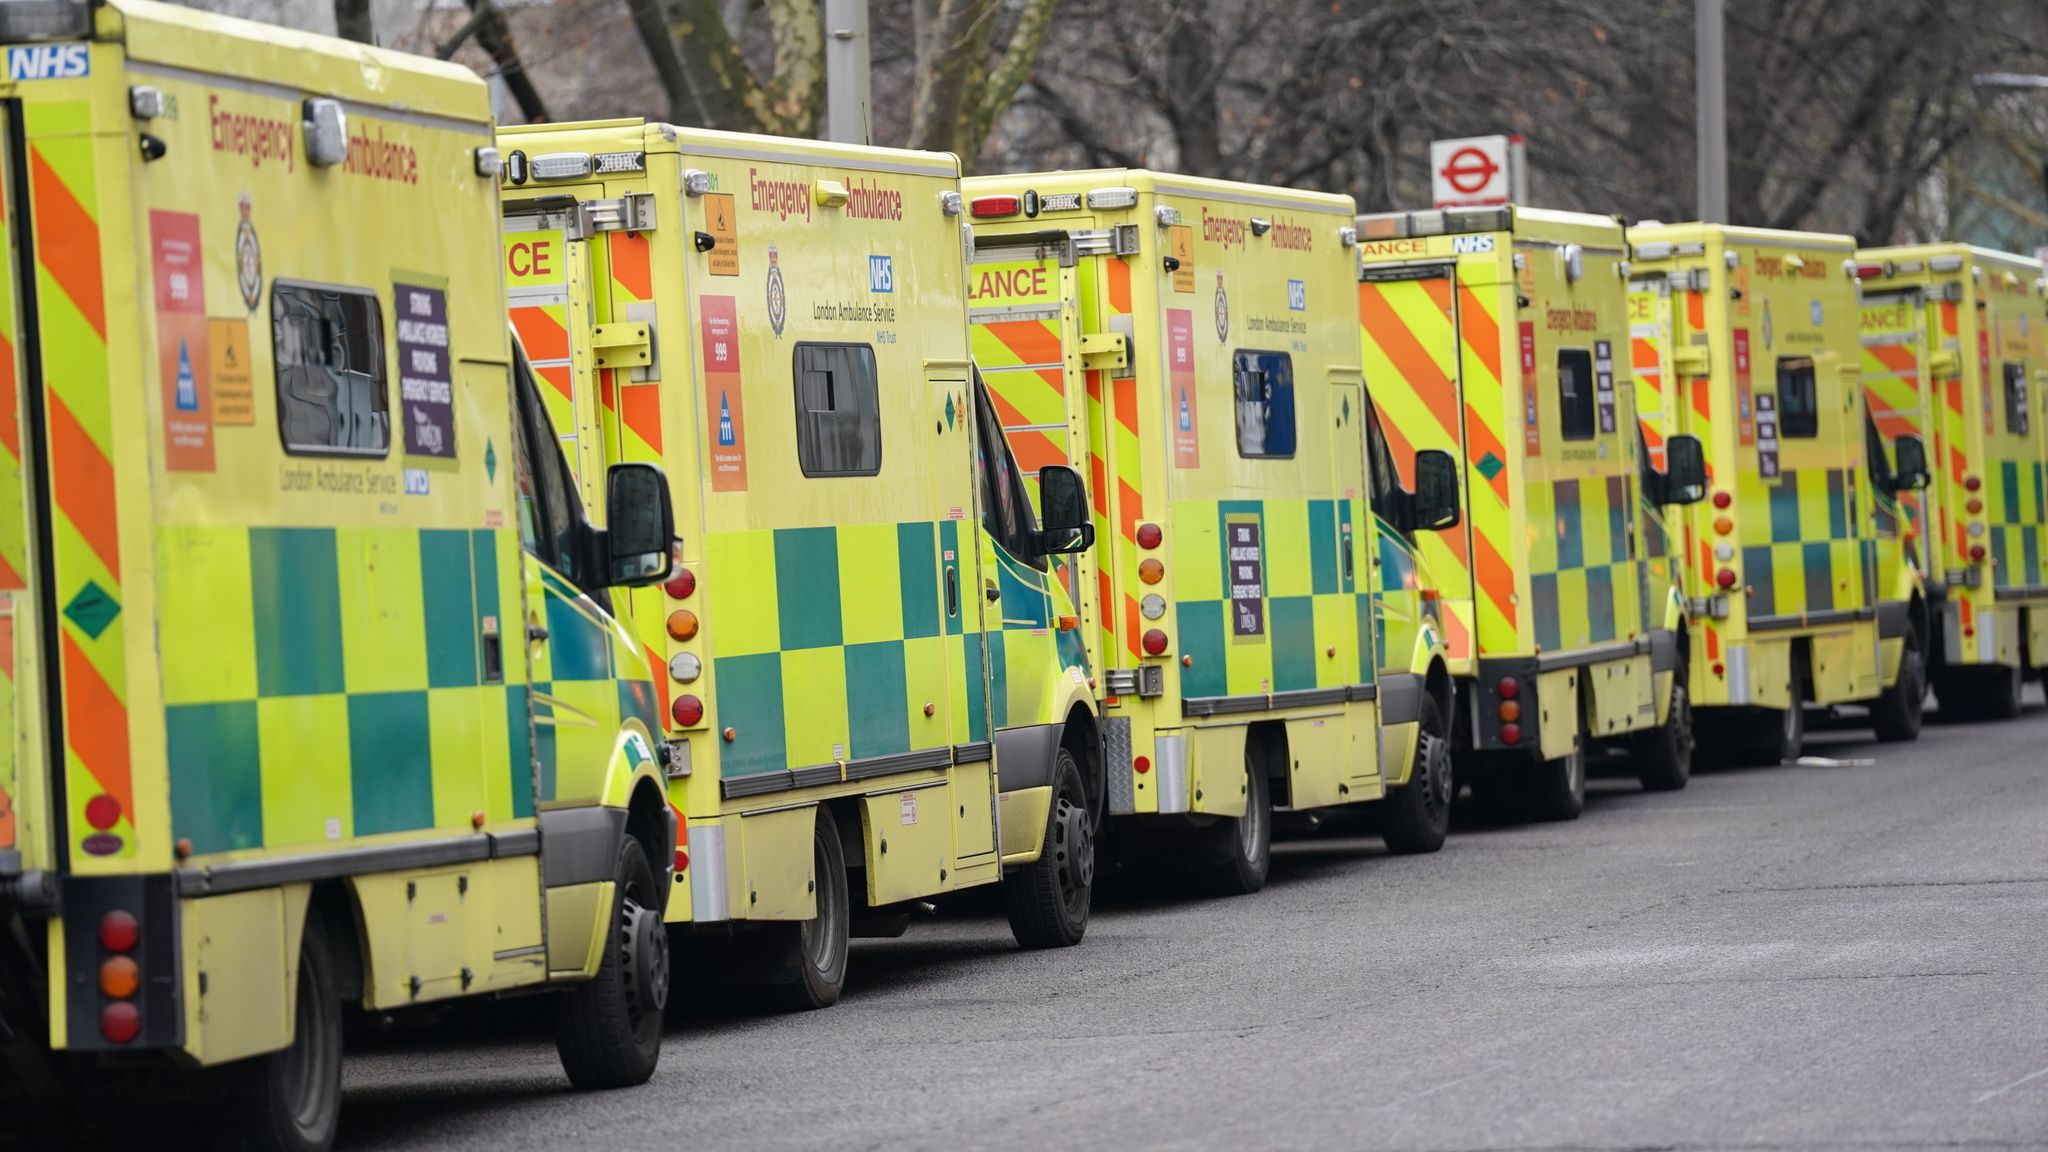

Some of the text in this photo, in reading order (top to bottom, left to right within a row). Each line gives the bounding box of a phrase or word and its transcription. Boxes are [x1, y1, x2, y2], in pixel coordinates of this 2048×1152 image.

[9, 45, 88, 79] NHS
[210, 96, 293, 174] Emergency
[750, 168, 902, 223] Emergency Ambulance
[1202, 207, 1312, 252] Emergency Ambulance
[1453, 235, 1494, 253] NHS
[504, 241, 551, 277] CE
[1363, 239, 1424, 256] ANCE
[869, 257, 892, 291] NHS
[813, 301, 895, 323] London Ambulance Service
[715, 342, 727, 361] 999
[721, 421, 732, 440] 111
